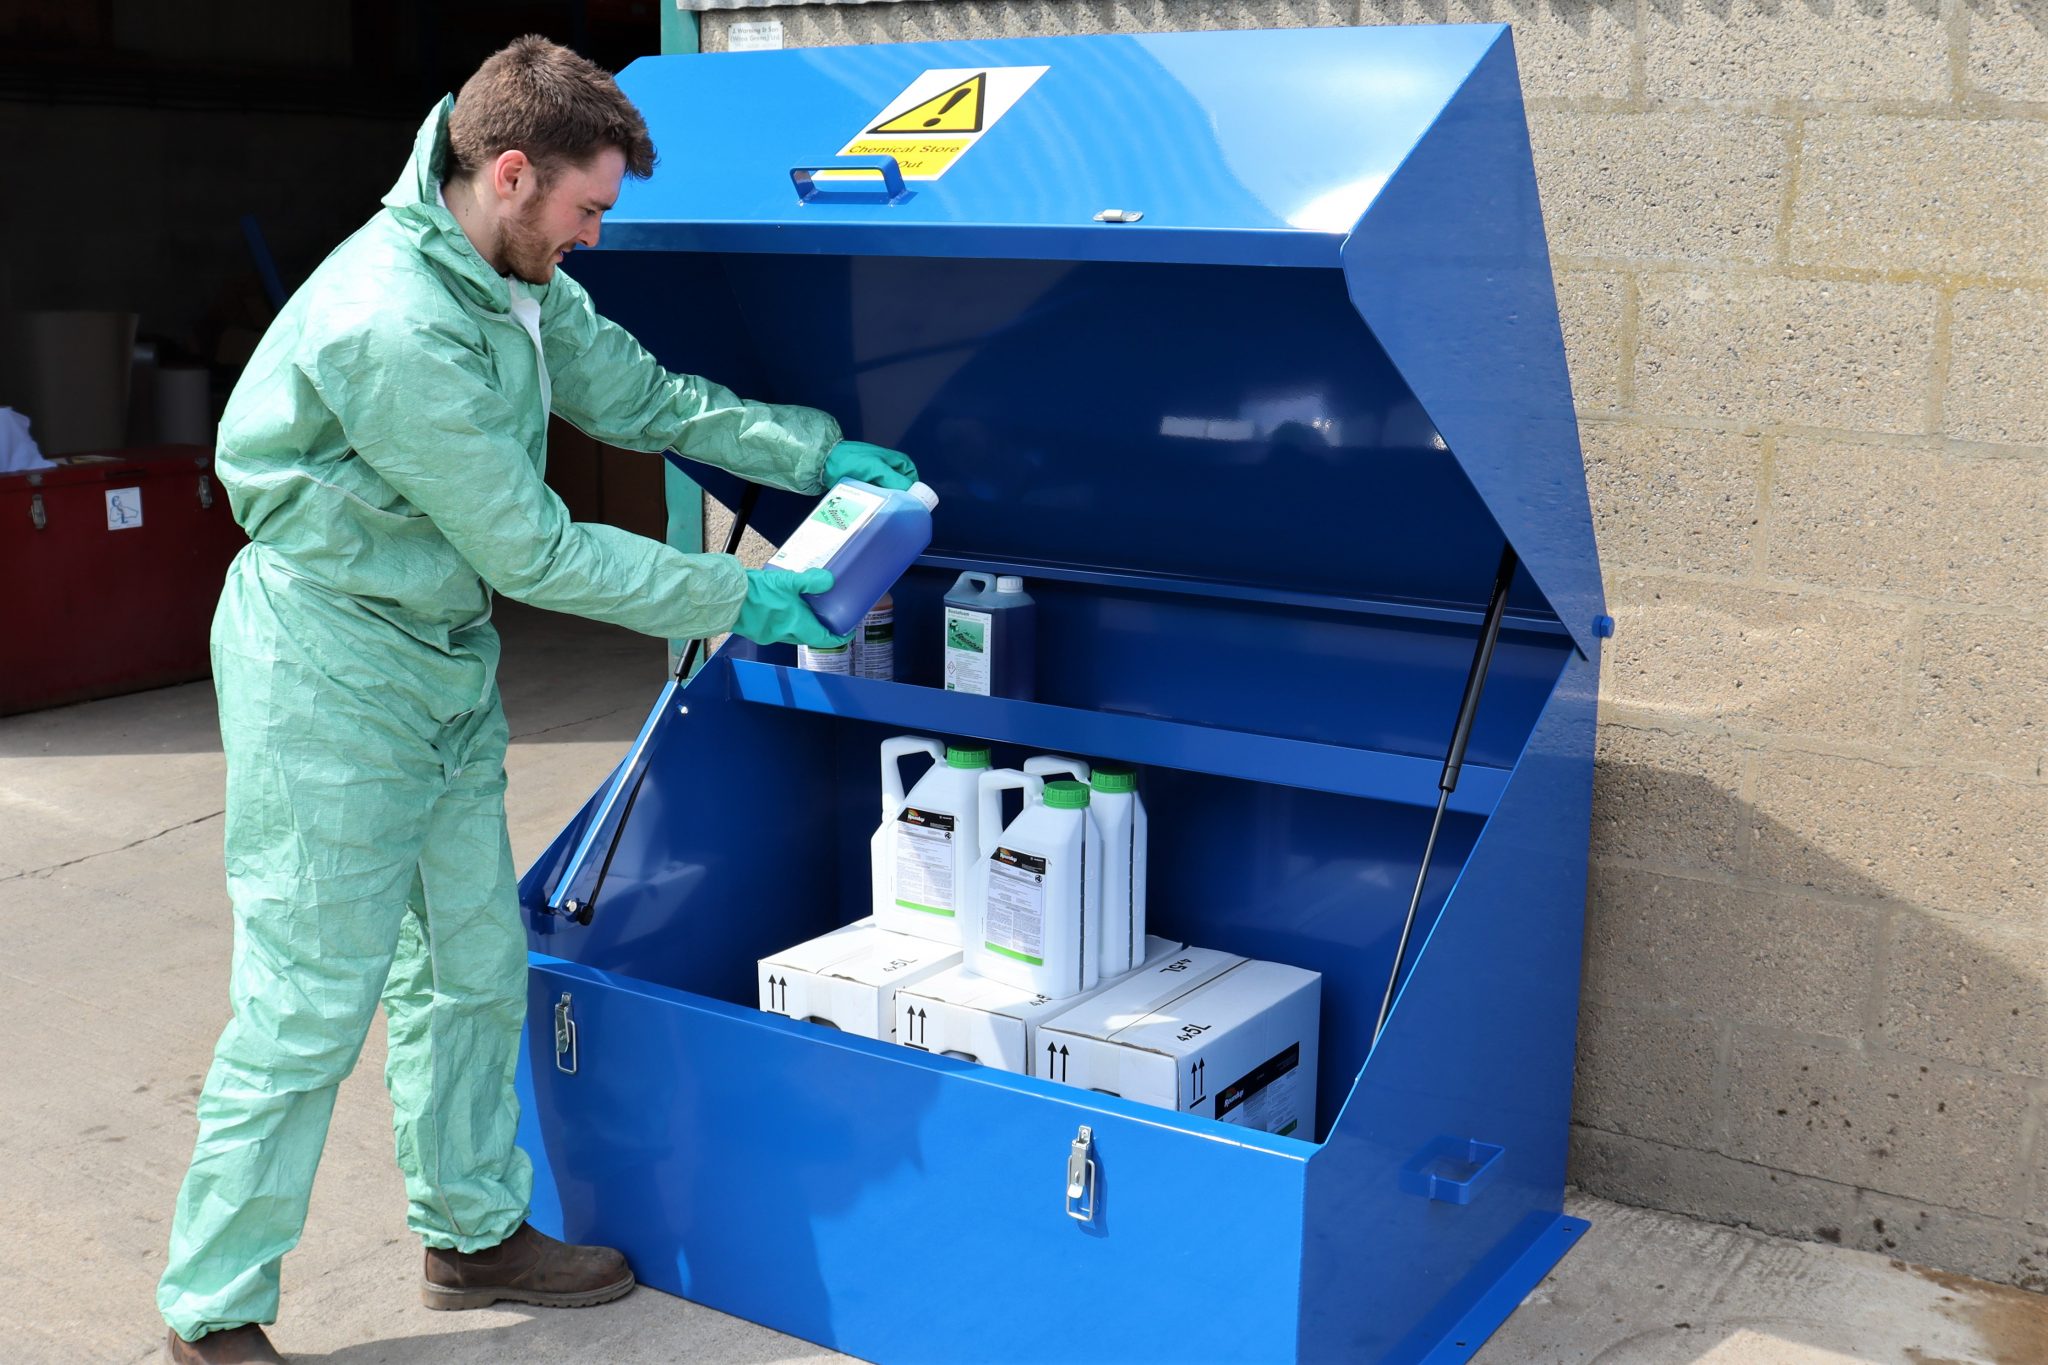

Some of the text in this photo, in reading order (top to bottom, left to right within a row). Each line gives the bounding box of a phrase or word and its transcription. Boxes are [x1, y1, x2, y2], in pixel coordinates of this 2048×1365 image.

[849, 145, 960, 154] Chemical Store
[898, 160, 923, 169] Out
[883, 959, 919, 972] 4x5L
[1160, 958, 1193, 973] 4x5L
[1176, 1023, 1212, 1042] 4x5L
